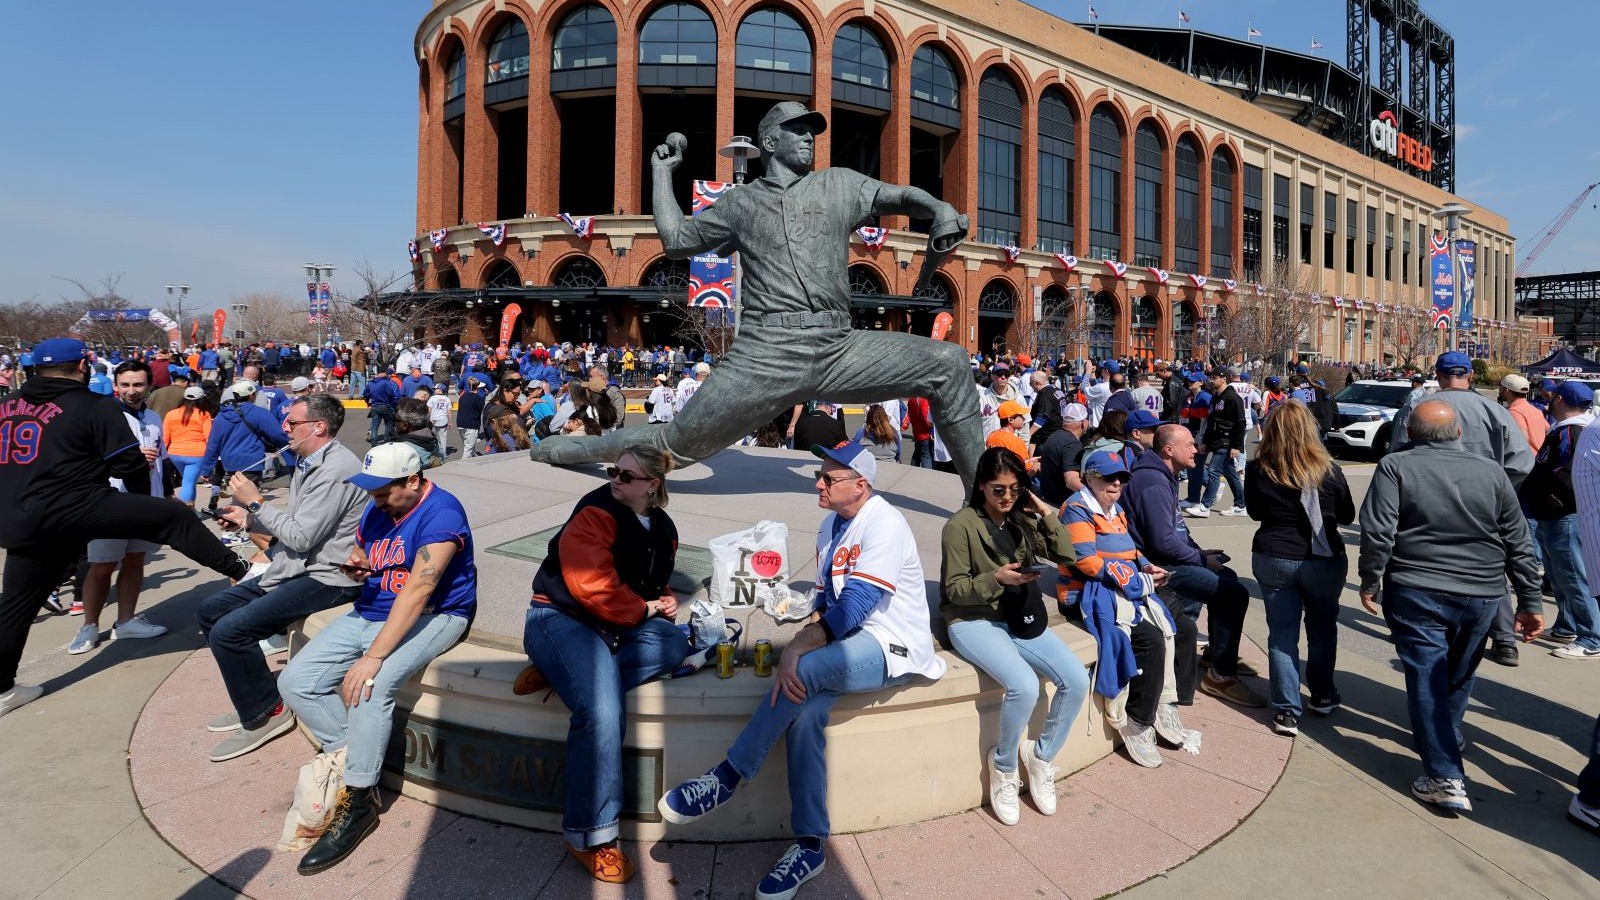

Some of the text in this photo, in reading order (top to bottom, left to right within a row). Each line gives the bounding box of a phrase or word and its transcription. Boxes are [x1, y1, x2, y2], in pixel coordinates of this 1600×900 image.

[1397, 132, 1432, 171] FIELD
[0, 398, 63, 424] ICHETTE
[1144, 394, 1160, 410] 41
[0, 420, 43, 464] 19
[734, 547, 754, 576] I
[381, 568, 411, 594] 18
[404, 727, 446, 774] OM
